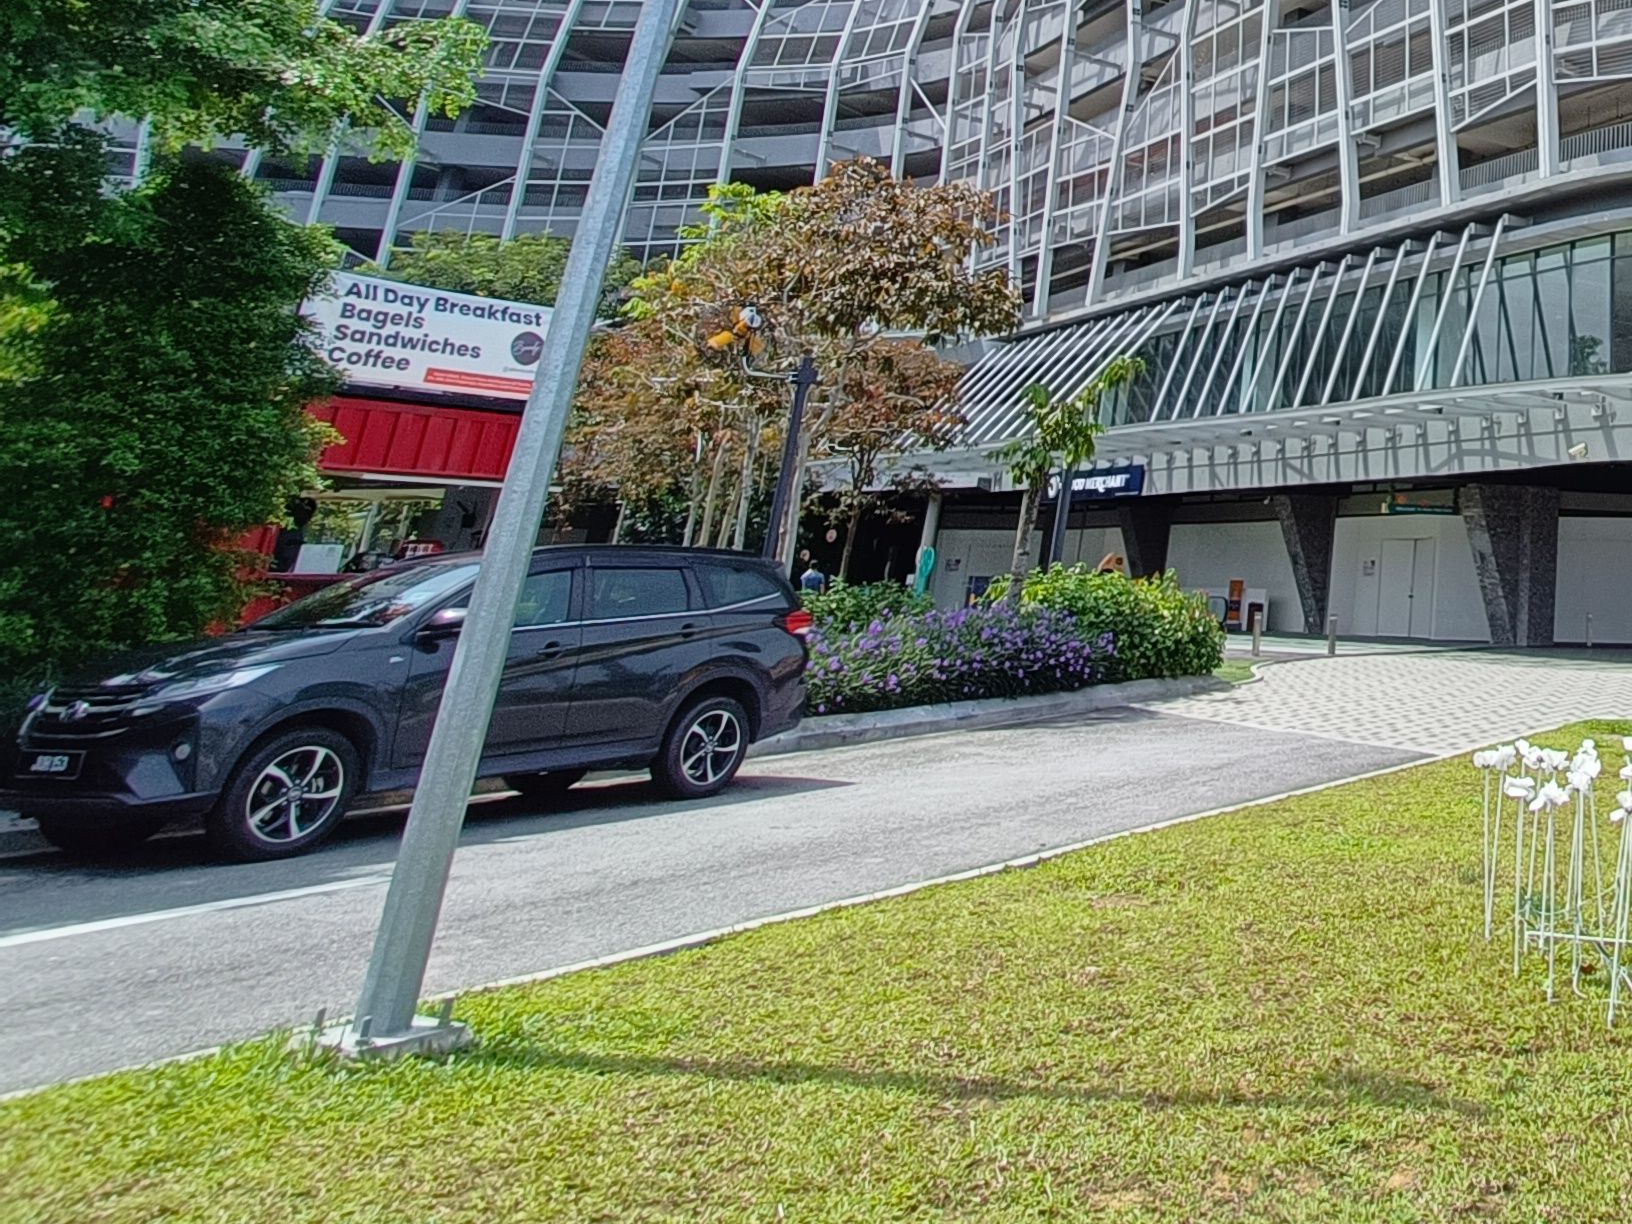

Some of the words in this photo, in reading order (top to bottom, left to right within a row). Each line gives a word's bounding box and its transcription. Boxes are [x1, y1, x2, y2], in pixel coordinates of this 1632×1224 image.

[340, 302, 425, 329] Bagels
[344, 282, 378, 302] All
[383, 288, 430, 314] Day
[434, 296, 543, 327] Breakfast
[333, 323, 482, 359] Sandwiches
[327, 346, 411, 371] Coffee
